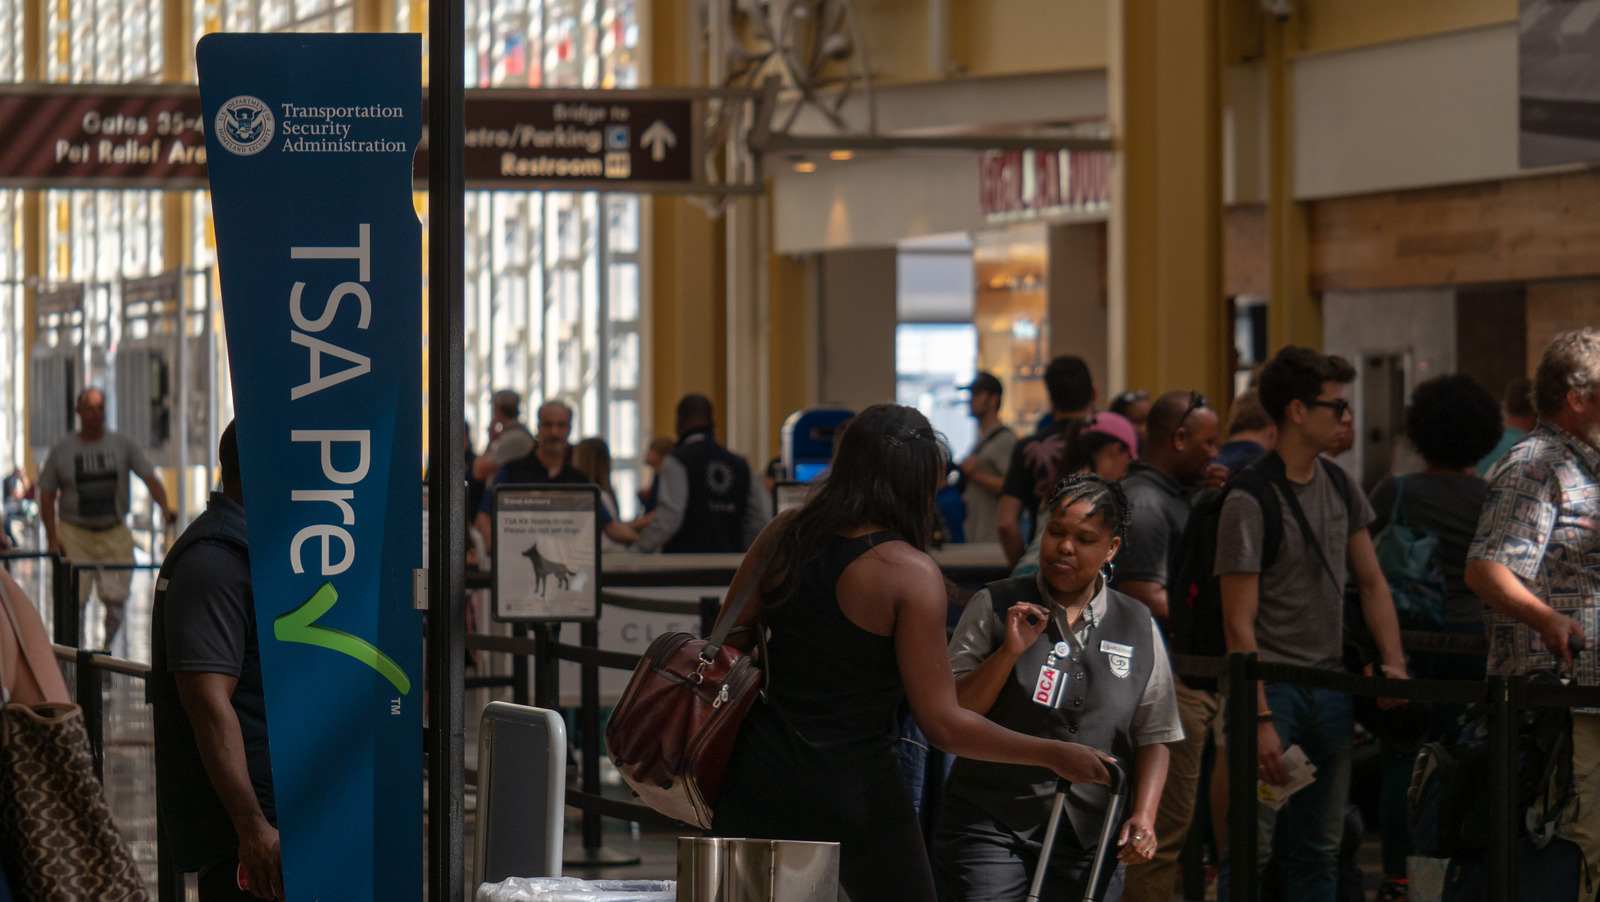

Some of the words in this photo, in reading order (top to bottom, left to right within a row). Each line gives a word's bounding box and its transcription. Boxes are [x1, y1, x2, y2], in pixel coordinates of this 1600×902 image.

[227, 98, 267, 114] DEPARTMENT
[281, 103, 404, 122] Transportation
[553, 103, 606, 125] Bridge
[610, 106, 630, 121] to
[83, 110, 148, 135] Gates
[282, 121, 352, 139] Security
[98, 138, 161, 164] Relief
[218, 128, 247, 152] HOMELAND
[248, 128, 272, 152] SECURITY
[282, 137, 407, 152] Administration
[501, 152, 603, 177] Restroom
[289, 223, 372, 401] TSA
[289, 429, 371, 576] Pre
[1036, 670, 1056, 703] DCA
